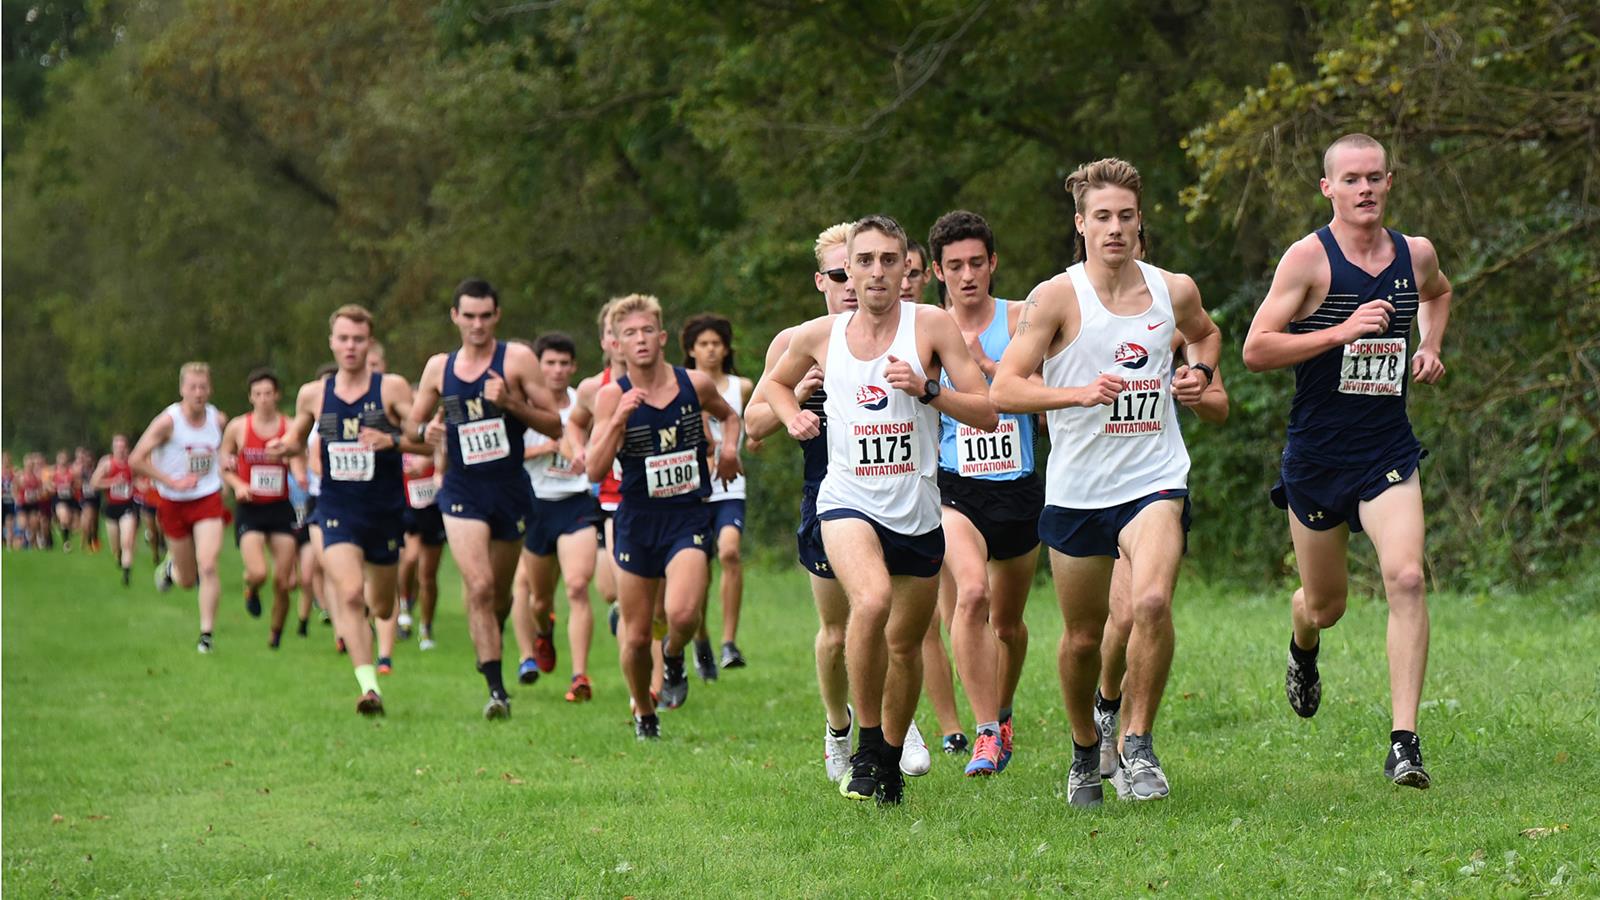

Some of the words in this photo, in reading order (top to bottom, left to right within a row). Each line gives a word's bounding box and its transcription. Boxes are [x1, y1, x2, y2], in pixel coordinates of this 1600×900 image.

[1350, 342, 1402, 355] DICKINSON
[1348, 355, 1399, 381] 1178
[1121, 378, 1161, 392] KINSON
[465, 397, 484, 420] N
[1110, 391, 1160, 421] 1177
[853, 421, 914, 436] DICKINSON
[960, 422, 1014, 436] DICKSON
[1105, 420, 1162, 434] INVITATIONAL
[467, 432, 500, 451] 1181
[658, 426, 677, 452] N
[858, 435, 912, 465] 1175
[964, 435, 1012, 462] 1016
[649, 454, 694, 468] DICKINSON
[855, 462, 916, 477] INVITATIONAL
[962, 460, 1017, 473] INVITATIONAL
[654, 464, 693, 488] 1180
